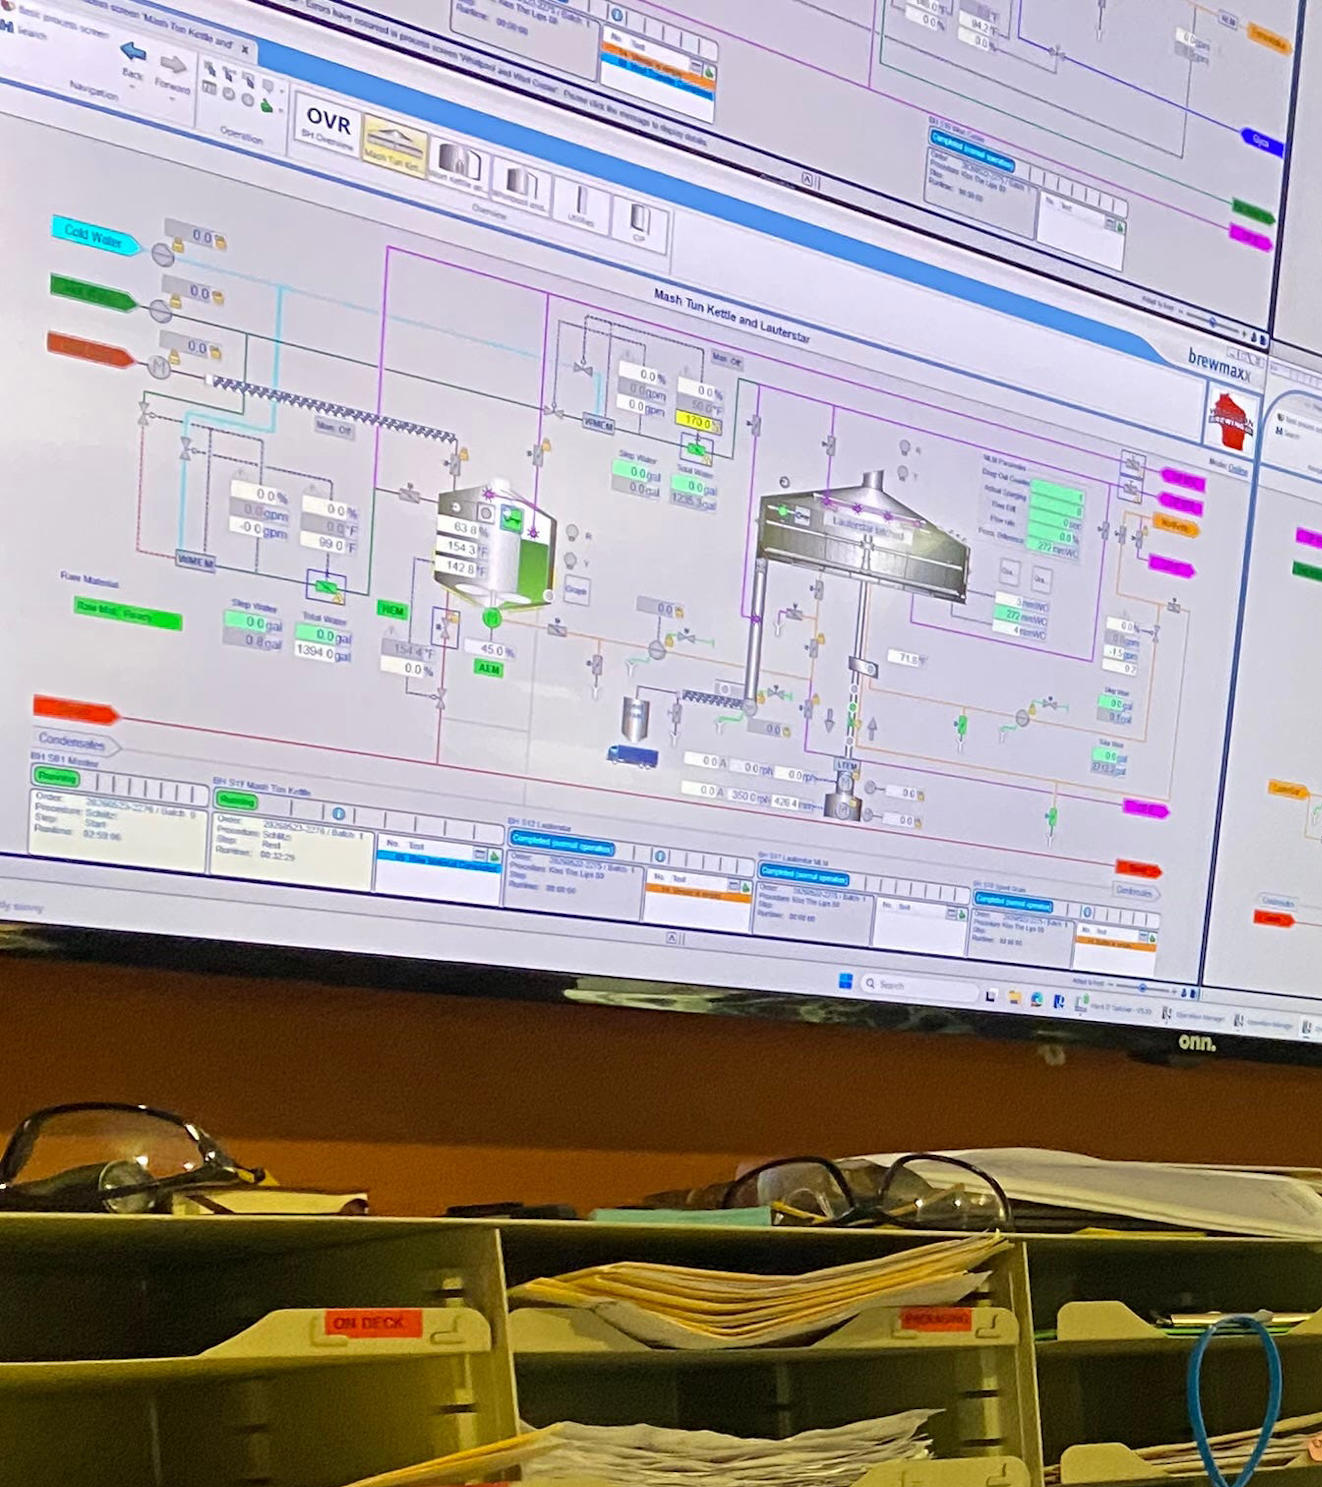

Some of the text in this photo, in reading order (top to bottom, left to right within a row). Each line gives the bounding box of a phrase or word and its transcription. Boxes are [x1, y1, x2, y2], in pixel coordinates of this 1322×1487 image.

[306, 106, 351, 136] OVR
[64, 223, 123, 250] Cold Water
[192, 229, 213, 244] 0.0
[190, 284, 210, 300] 0.0
[654, 288, 682, 306] Mash
[686, 298, 705, 312] Tun
[707, 304, 737, 321] Kettle
[739, 312, 757, 326] and
[188, 339, 208, 355] 0.0
[1188, 347, 1252, 383] brewmaxx
[453, 521, 477, 536] 63.8
[448, 539, 476, 556] 154.3
[446, 559, 475, 576] 142.8
[1005, 611, 1021, 622] 272
[265, 619, 283, 634] gal
[264, 637, 282, 652] gal
[335, 632, 352, 647] gal
[334, 649, 351, 664] gal
[481, 643, 504, 657] 45.0
[1178, 1033, 1217, 1054] onn.
[334, 1317, 404, 1329] ON DECK
